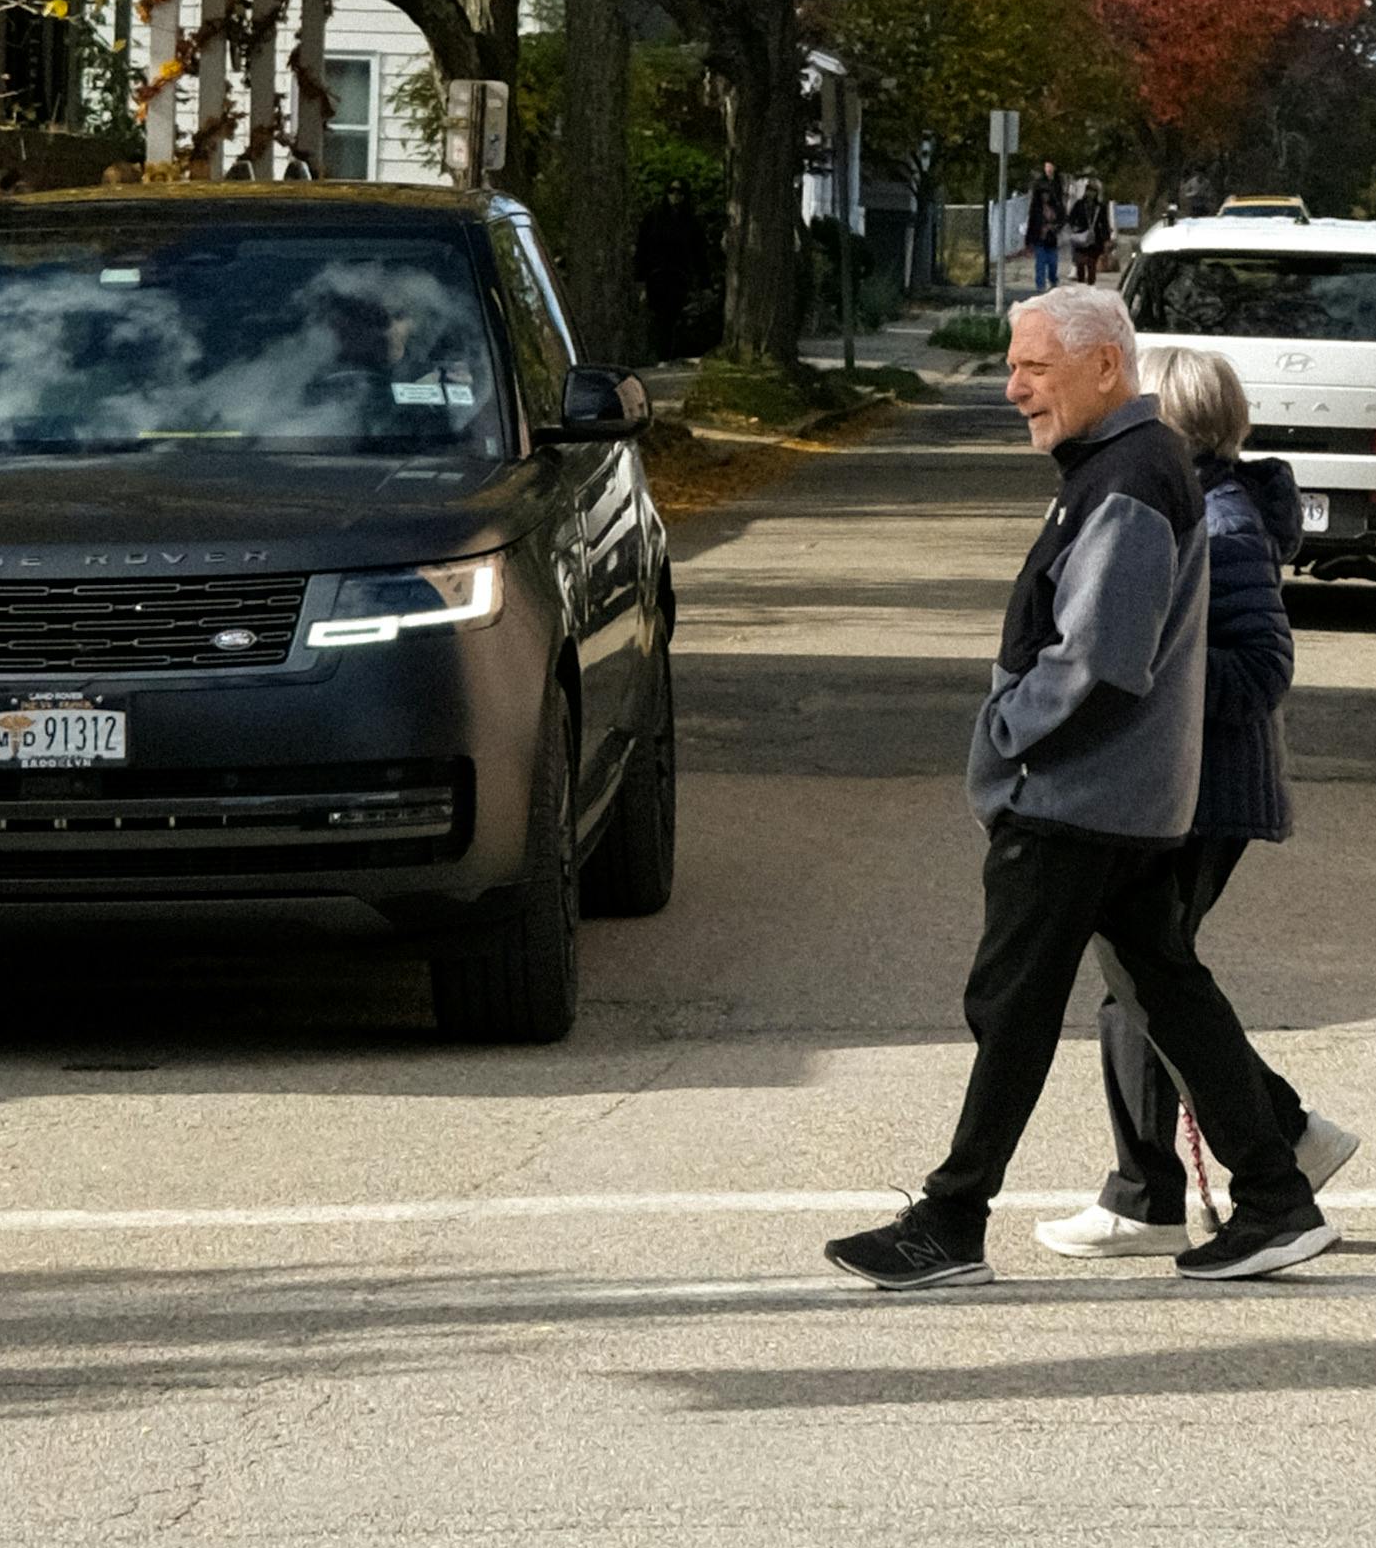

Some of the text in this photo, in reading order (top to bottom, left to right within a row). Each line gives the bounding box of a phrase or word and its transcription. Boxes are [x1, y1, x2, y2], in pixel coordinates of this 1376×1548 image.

[1247, 401, 1331, 413] NTA
[84, 550, 270, 565] ROVER
[44, 716, 117, 752] 91312
